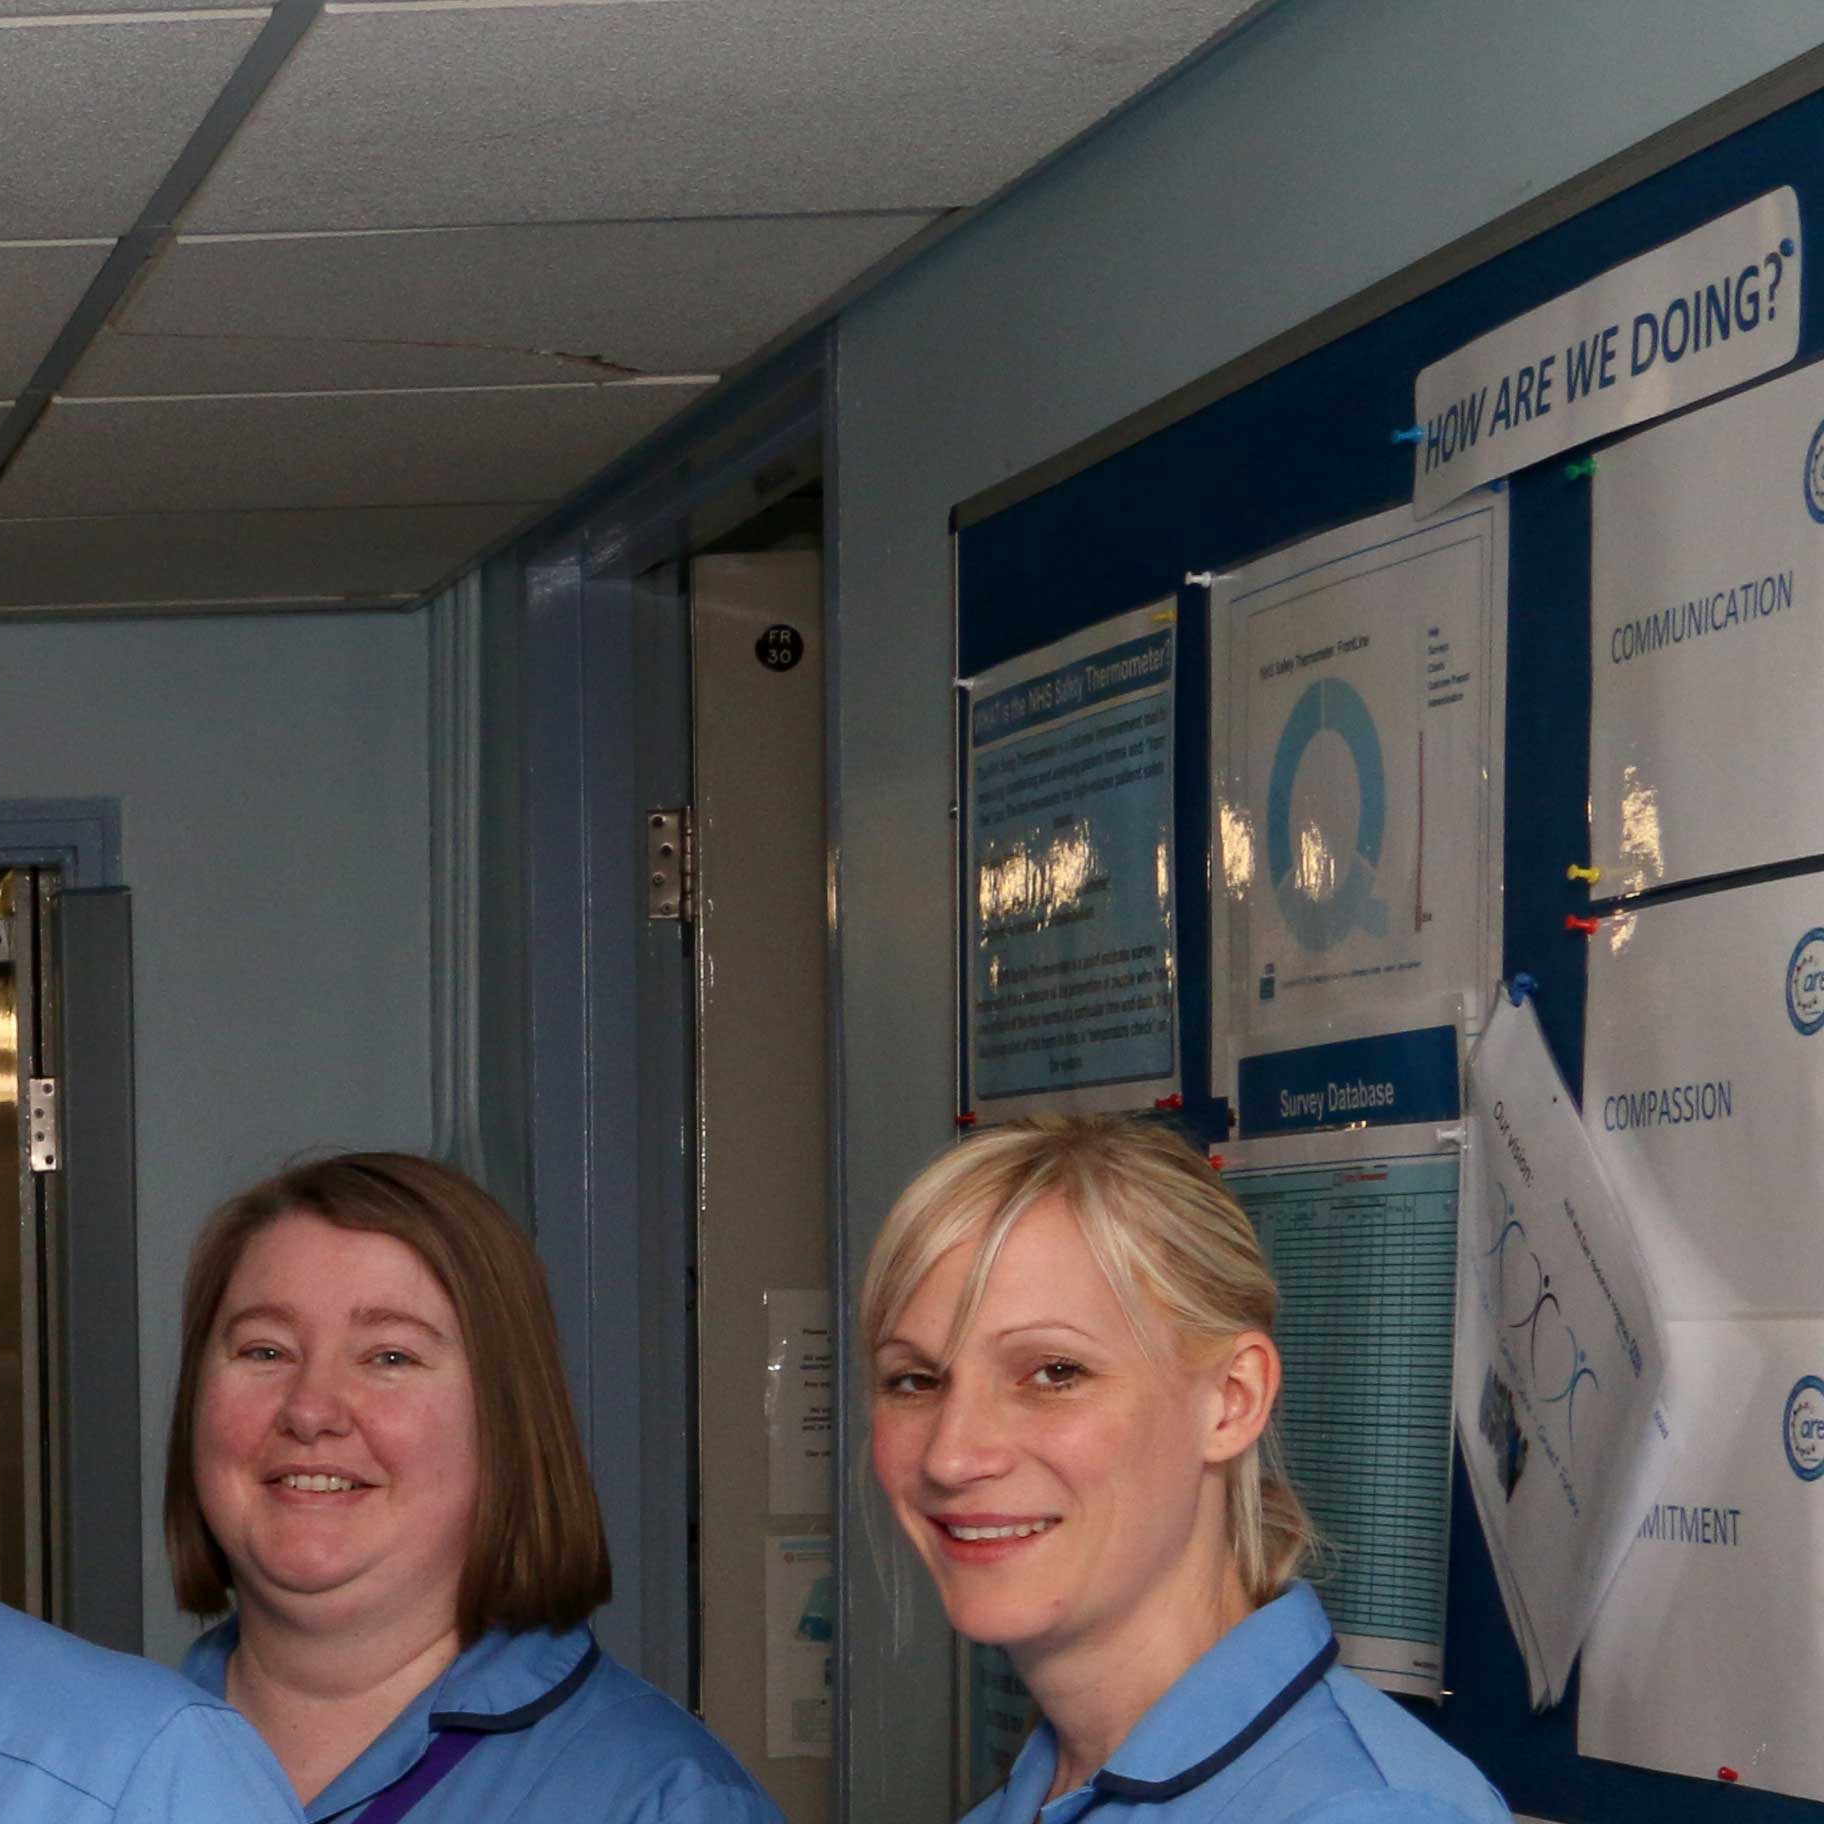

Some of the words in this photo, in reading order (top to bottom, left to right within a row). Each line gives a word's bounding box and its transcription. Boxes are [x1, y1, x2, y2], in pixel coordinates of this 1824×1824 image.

[1425, 386, 1488, 474] HOW
[1488, 355, 1556, 437] ARE
[1566, 325, 1619, 403] WE
[1630, 251, 1784, 378] DOING?
[768, 630, 791, 644] FR
[1611, 570, 1793, 664] COMMUNICATION
[767, 649, 792, 664] 30
[1280, 1087, 1324, 1121] Survey
[1327, 1079, 1395, 1110] Database
[1604, 1080, 1732, 1132] COMPASSION
[1638, 1504, 1741, 1546] MITMENT
